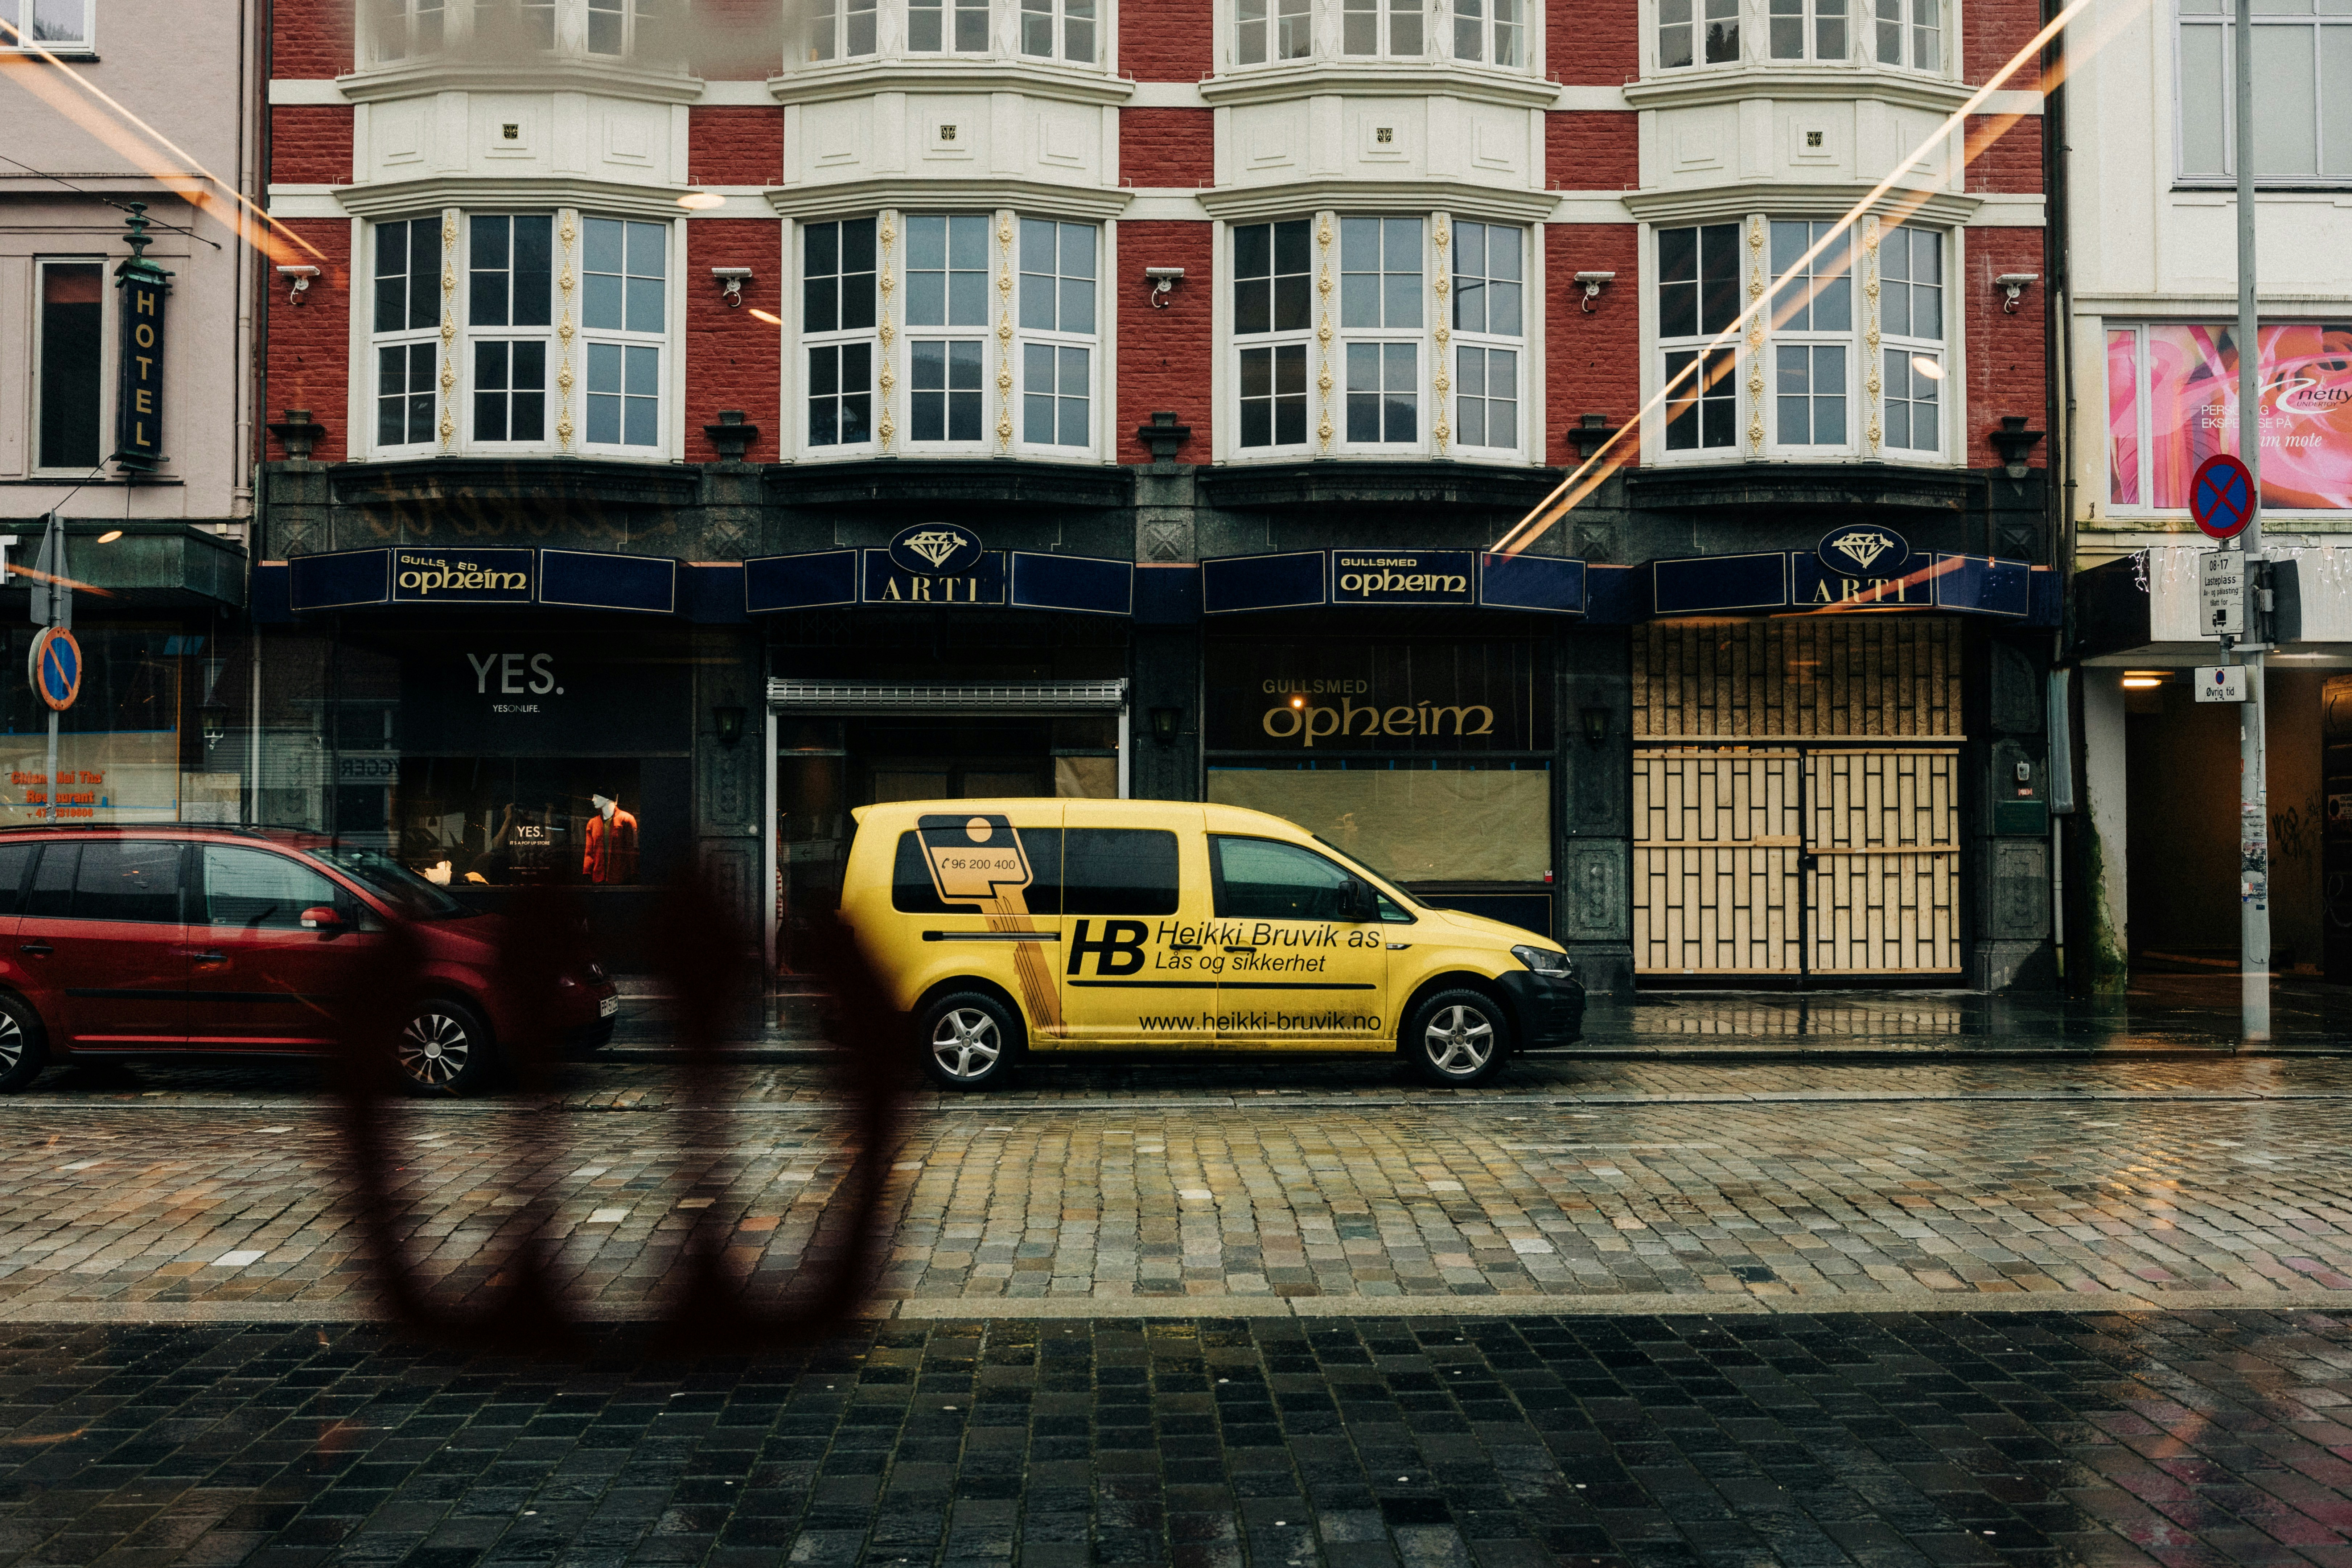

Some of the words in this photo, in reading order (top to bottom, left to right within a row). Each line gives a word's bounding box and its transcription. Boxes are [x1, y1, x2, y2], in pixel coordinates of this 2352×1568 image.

[136, 291, 155, 446] HOTEL
[2299, 388, 2352, 404] netty
[2201, 405, 2269, 415] PERSOG
[2201, 418, 2273, 428] EKSPESE
[2276, 415, 2292, 428] PÅ
[2285, 433, 2322, 447] mote
[1341, 558, 1416, 567] GULLSMED
[1340, 569, 1466, 596] opheim
[2205, 575, 2236, 587] Lasteplass
[881, 576, 977, 601] ARTI
[1813, 578, 1906, 602] ARTI
[2217, 588, 2238, 597] pålasting
[466, 653, 564, 694] YES.
[1263, 679, 1368, 694] GULLSMED
[2207, 687, 2223, 698] Øvrig
[11, 771, 48, 785] Chian
[26, 790, 94, 803] Resaurant
[517, 826, 543, 837] YES.
[951, 859, 966, 869] 96
[969, 859, 991, 869] 200
[994, 859, 1015, 869] 400
[1156, 921, 1243, 945] Heikki
[1252, 923, 1340, 947] Bruvik
[1348, 930, 1380, 948] as
[1066, 919, 1149, 975] HB
[1155, 951, 1192, 970] Lås
[1200, 956, 1223, 974] og
[1232, 954, 1326, 972] sikkerhet
[1139, 1012, 1381, 1031] www.heikki-bruvik.no
